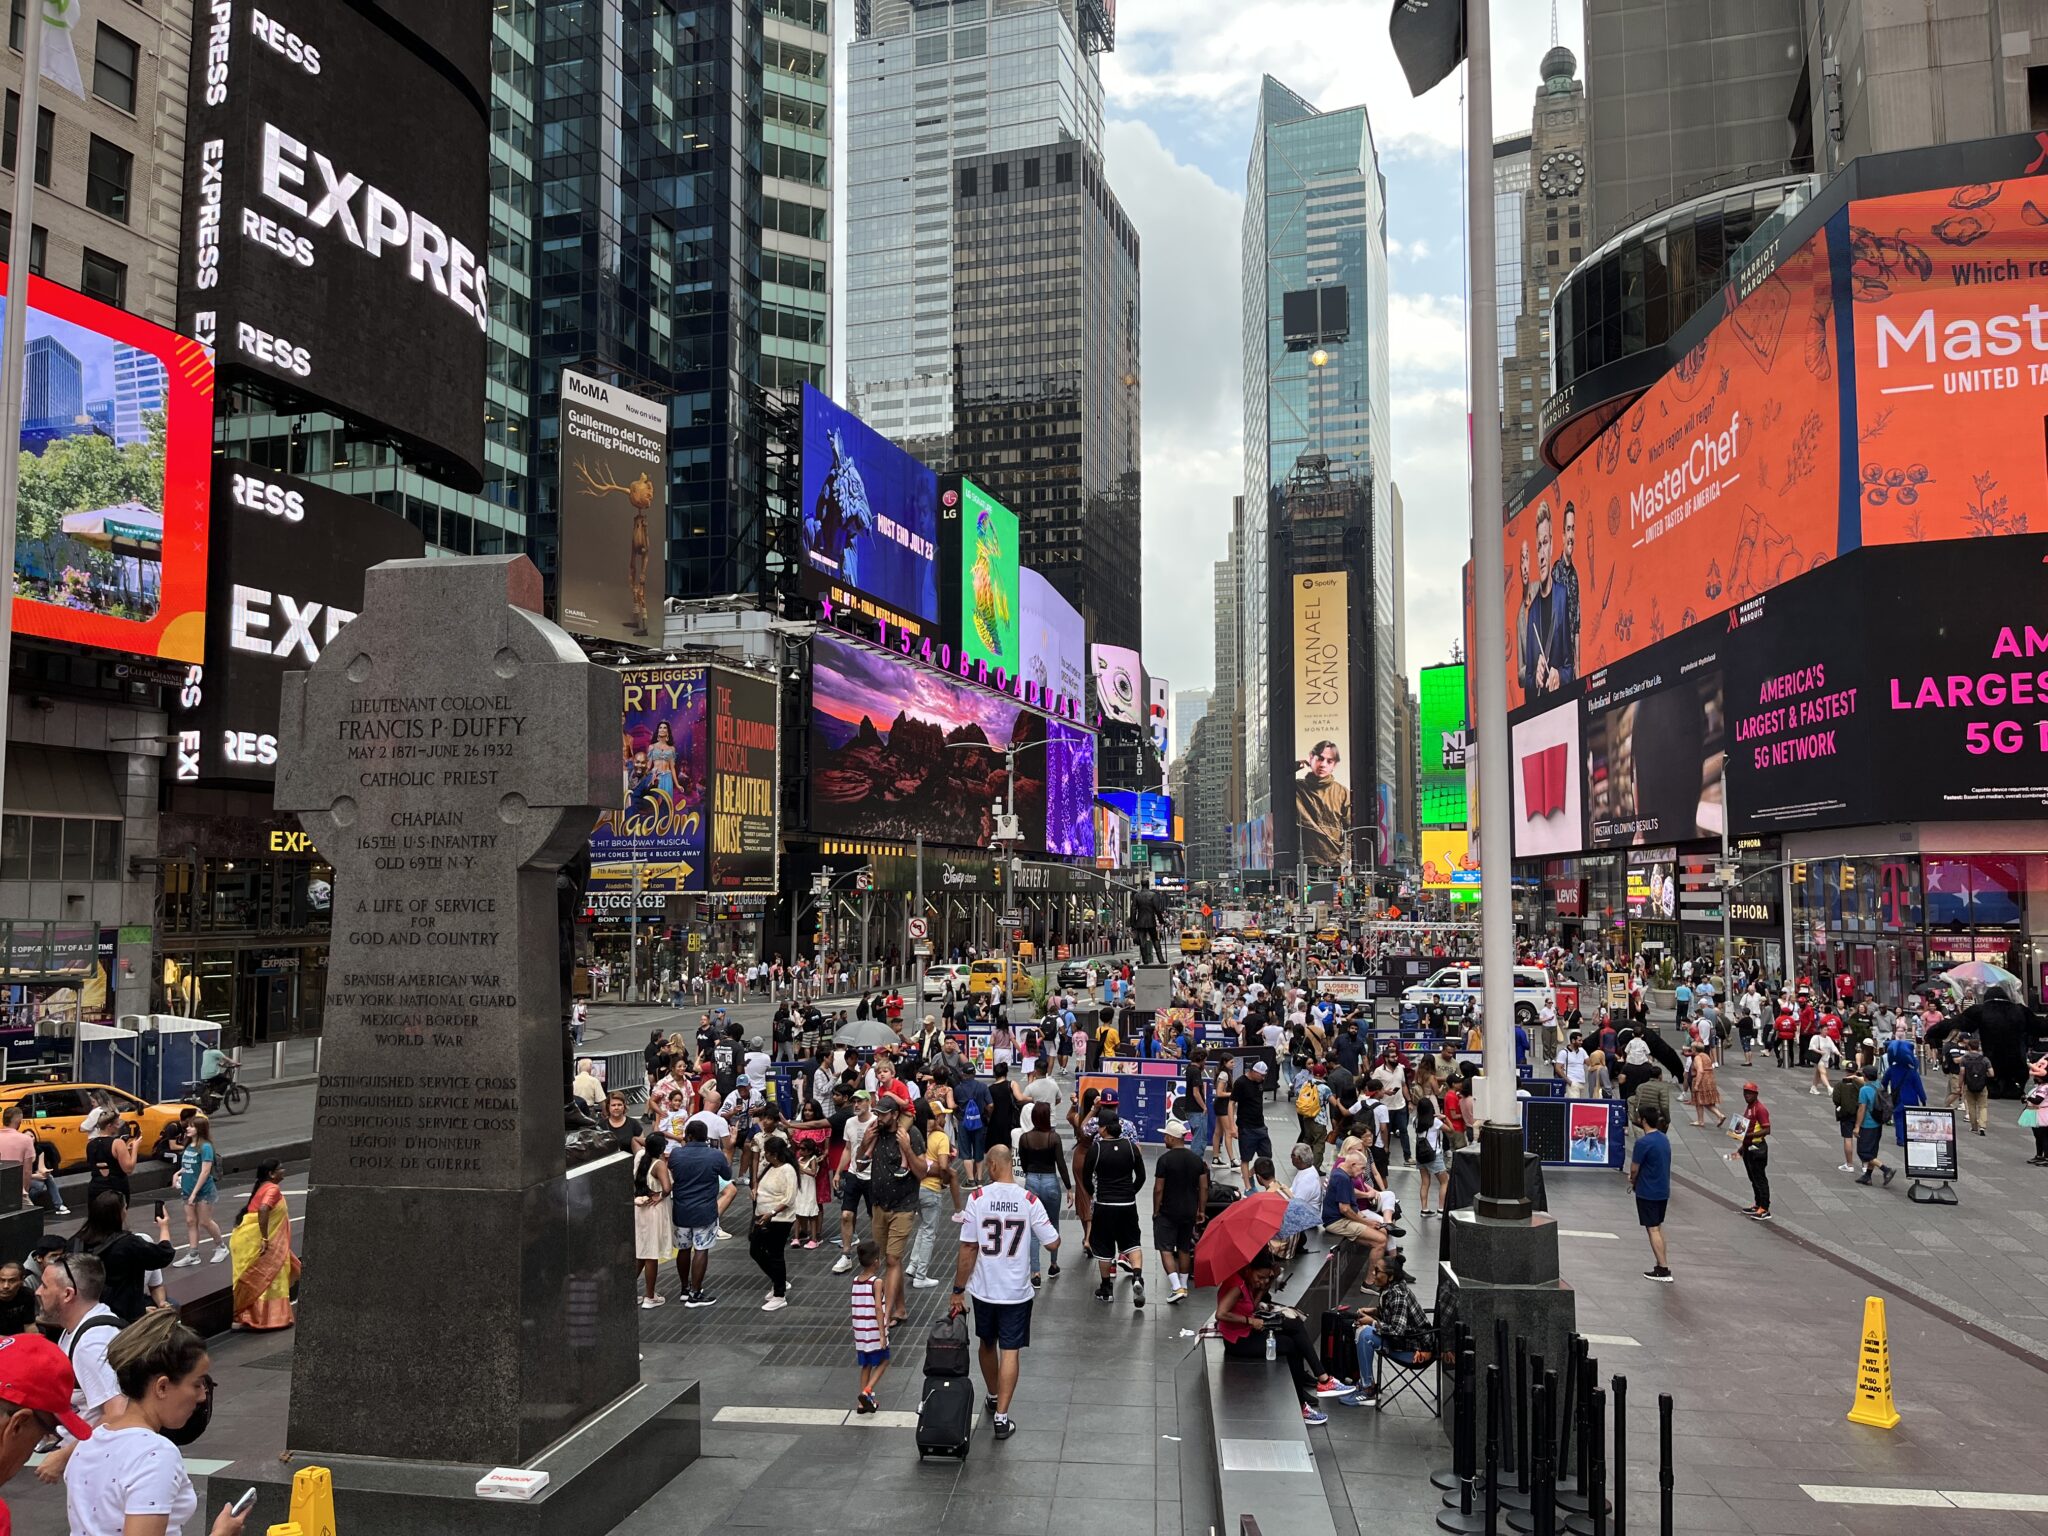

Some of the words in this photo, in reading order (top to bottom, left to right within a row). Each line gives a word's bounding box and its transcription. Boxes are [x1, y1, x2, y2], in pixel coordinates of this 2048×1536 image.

[252, 8, 321, 75] RESS
[197, 138, 224, 290] EXPRESS
[242, 206, 315, 267] RESS
[1740, 238, 1780, 284] MARRIOTT
[1740, 260, 1776, 300] MARQUIS
[1951, 258, 2020, 286] Which
[238, 321, 312, 377] RESS
[569, 376, 609, 404] MoMA
[1943, 366, 2019, 395] UNITED
[625, 404, 639, 415] Now
[648, 413, 662, 424] view
[568, 409, 620, 437] Guillermo
[620, 428, 636, 443] del
[637, 433, 662, 452] Toro:
[1665, 429, 1683, 451] region
[1684, 418, 1695, 436] will
[1695, 398, 1716, 428] reign?
[568, 423, 612, 450] Crafting
[612, 439, 661, 464] Pinocchio
[1630, 410, 1739, 530] MasterChef
[943, 509, 957, 519] LG
[1645, 520, 1664, 544] UNITED
[1665, 504, 1684, 532] TASTES
[1684, 498, 1692, 519] OF
[1693, 480, 1721, 513] AMERICA
[877, 512, 896, 540] MUST
[896, 525, 909, 548] END
[910, 532, 925, 557] JULY
[925, 542, 934, 561] 23
[1314, 579, 1337, 589] Spotify
[831, 586, 843, 603] LIFE
[843, 591, 851, 607] OF
[1739, 595, 1766, 614] MARRIOTT
[1740, 608, 1763, 625] MARQUIS
[1305, 597, 1322, 705] NATANAEL
[652, 668, 705, 682] BIGGEST
[1322, 644, 1339, 705] CANO
[1759, 663, 1825, 705] AMERICA'S
[960, 650, 1078, 720] BROADWAY
[350, 697, 438, 714] LIEUTENANT
[440, 696, 512, 712] COLONEL
[716, 686, 732, 716] THE
[1736, 707, 1785, 742] LARGEST
[1788, 705, 1798, 728] &
[1799, 688, 1857, 727] FASTEST
[338, 718, 424, 740] FRANCIS
[452, 716, 528, 738] DUFFY
[716, 715, 736, 745] NEIL
[736, 720, 776, 751] DIAMOND
[1965, 720, 2024, 755] 5G
[348, 747, 378, 760] MAY
[379, 747, 388, 759] 2
[464, 744, 480, 757] 26
[483, 744, 513, 757] 1932
[716, 742, 751, 774] MUSICAL
[1754, 746, 1770, 771] 5G
[1772, 730, 1837, 766] NETWORK
[1136, 746, 1144, 775] 1500
[359, 772, 436, 787] CATHOLIC
[443, 770, 500, 785] PRIEST
[714, 773, 722, 813] A
[723, 775, 773, 817] BEAUTIFUL
[390, 811, 464, 827] CHAPLAIN
[1594, 822, 1614, 838] INSTANT
[1614, 820, 1636, 835] GLOWING
[1636, 817, 1659, 833] RESULTS
[356, 835, 397, 850] 165TH
[430, 834, 498, 849] INFANTRY
[611, 839, 656, 847] BROADWAY
[656, 838, 691, 846] MUSICAL
[713, 814, 743, 855] NOISE
[1737, 838, 1761, 849] SEPHORA
[374, 856, 405, 870] OLD
[409, 855, 443, 870] 69TH
[607, 867, 628, 875] Avenue
[964, 874, 977, 884] store
[1013, 867, 1042, 888] FOREVER
[1042, 868, 1050, 888] 21
[356, 900, 367, 913] A
[372, 899, 402, 913] LIFE
[408, 899, 429, 913] OF
[434, 899, 496, 913] SERVICE
[587, 895, 666, 909] LUGGAGE
[733, 894, 767, 905] LUGGAGE
[410, 916, 436, 928] FOR
[349, 931, 385, 945] GOD
[388, 931, 421, 945] AND
[426, 931, 500, 946] COUNTRY
[262, 957, 300, 968] EXPRESS
[343, 974, 395, 987] SPANISH
[398, 974, 467, 987] AMERICAN
[471, 974, 501, 987] WAR
[326, 994, 355, 1007] NEW
[359, 994, 394, 1007] YORK
[399, 994, 464, 1008] NATIONAL
[468, 995, 517, 1008] GUARD
[360, 1014, 422, 1027] MEXICAN
[426, 1014, 479, 1027] BORDER
[375, 1034, 424, 1047] WORLD
[433, 1034, 464, 1048] WAR
[319, 1075, 414, 1088] DISTINGUISHED
[418, 1076, 471, 1089] SERVICE
[474, 1077, 517, 1090] CROSS
[318, 1095, 413, 1108] DISTINGUISHED
[418, 1097, 470, 1110] SERVICE
[473, 1097, 519, 1110] MEDAL
[317, 1114, 412, 1129] CONSPICUOUS
[417, 1116, 469, 1130] SERVICE
[473, 1117, 516, 1131] CROSS
[405, 1136, 481, 1150] D'HONNEUR
[349, 1155, 395, 1170] CROIX
[400, 1156, 419, 1170] DE
[426, 1157, 481, 1171] GUERRE
[989, 1201, 1019, 1213] HARRIS
[981, 1217, 1027, 1257] 37
[1862, 1365, 1880, 1374] FLOOR
[1865, 1358, 1877, 1366] WET
[1859, 1384, 1882, 1393] MOJADO
[1864, 1377, 1877, 1385] PISO
